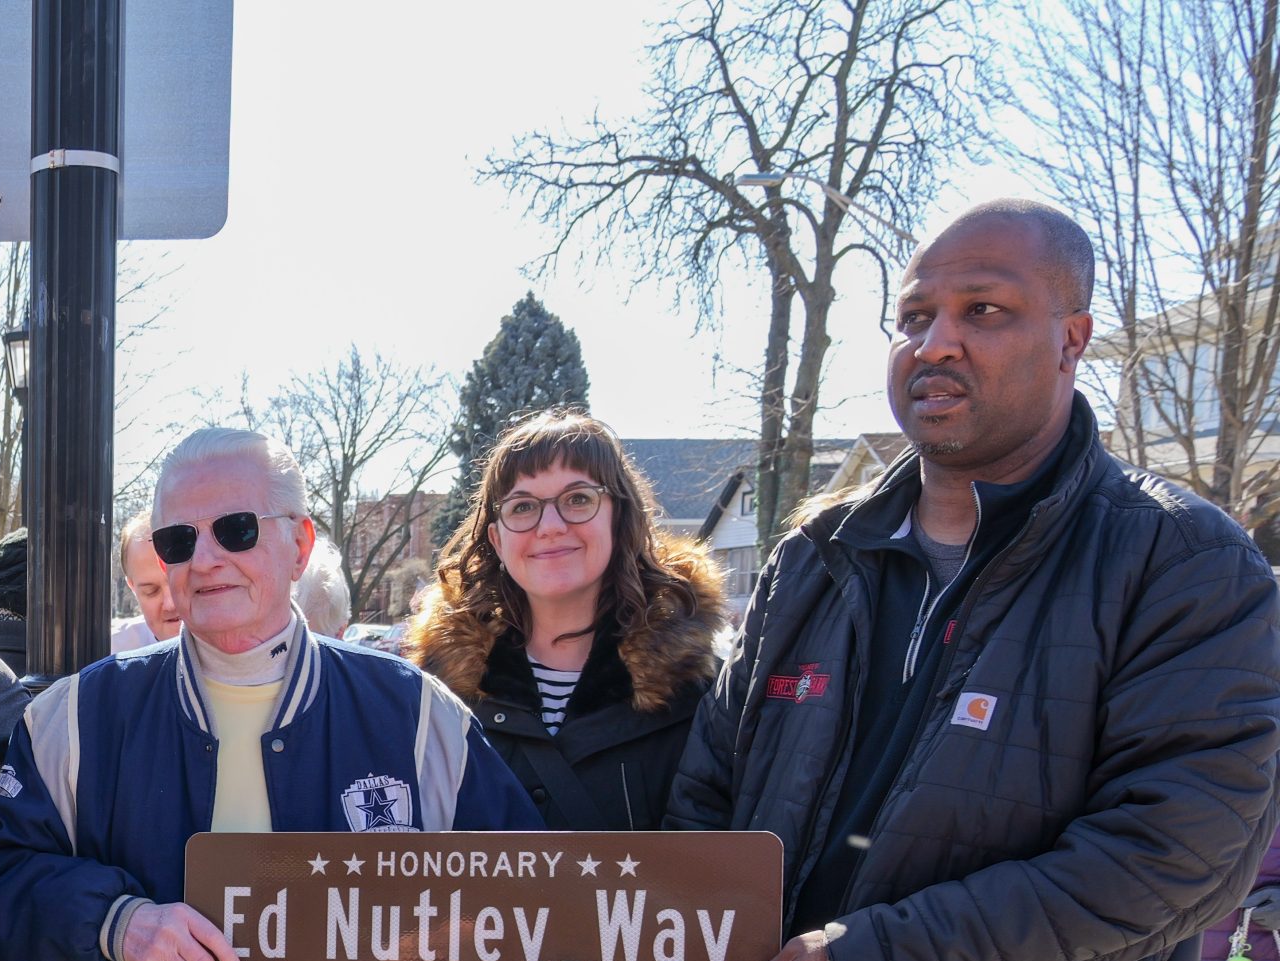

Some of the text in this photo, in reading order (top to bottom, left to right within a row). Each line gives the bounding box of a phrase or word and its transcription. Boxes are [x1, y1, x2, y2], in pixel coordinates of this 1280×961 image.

[357, 775, 390, 789] DALLAS
[376, 850, 564, 879] HONORARY
[223, 886, 288, 960] Ed
